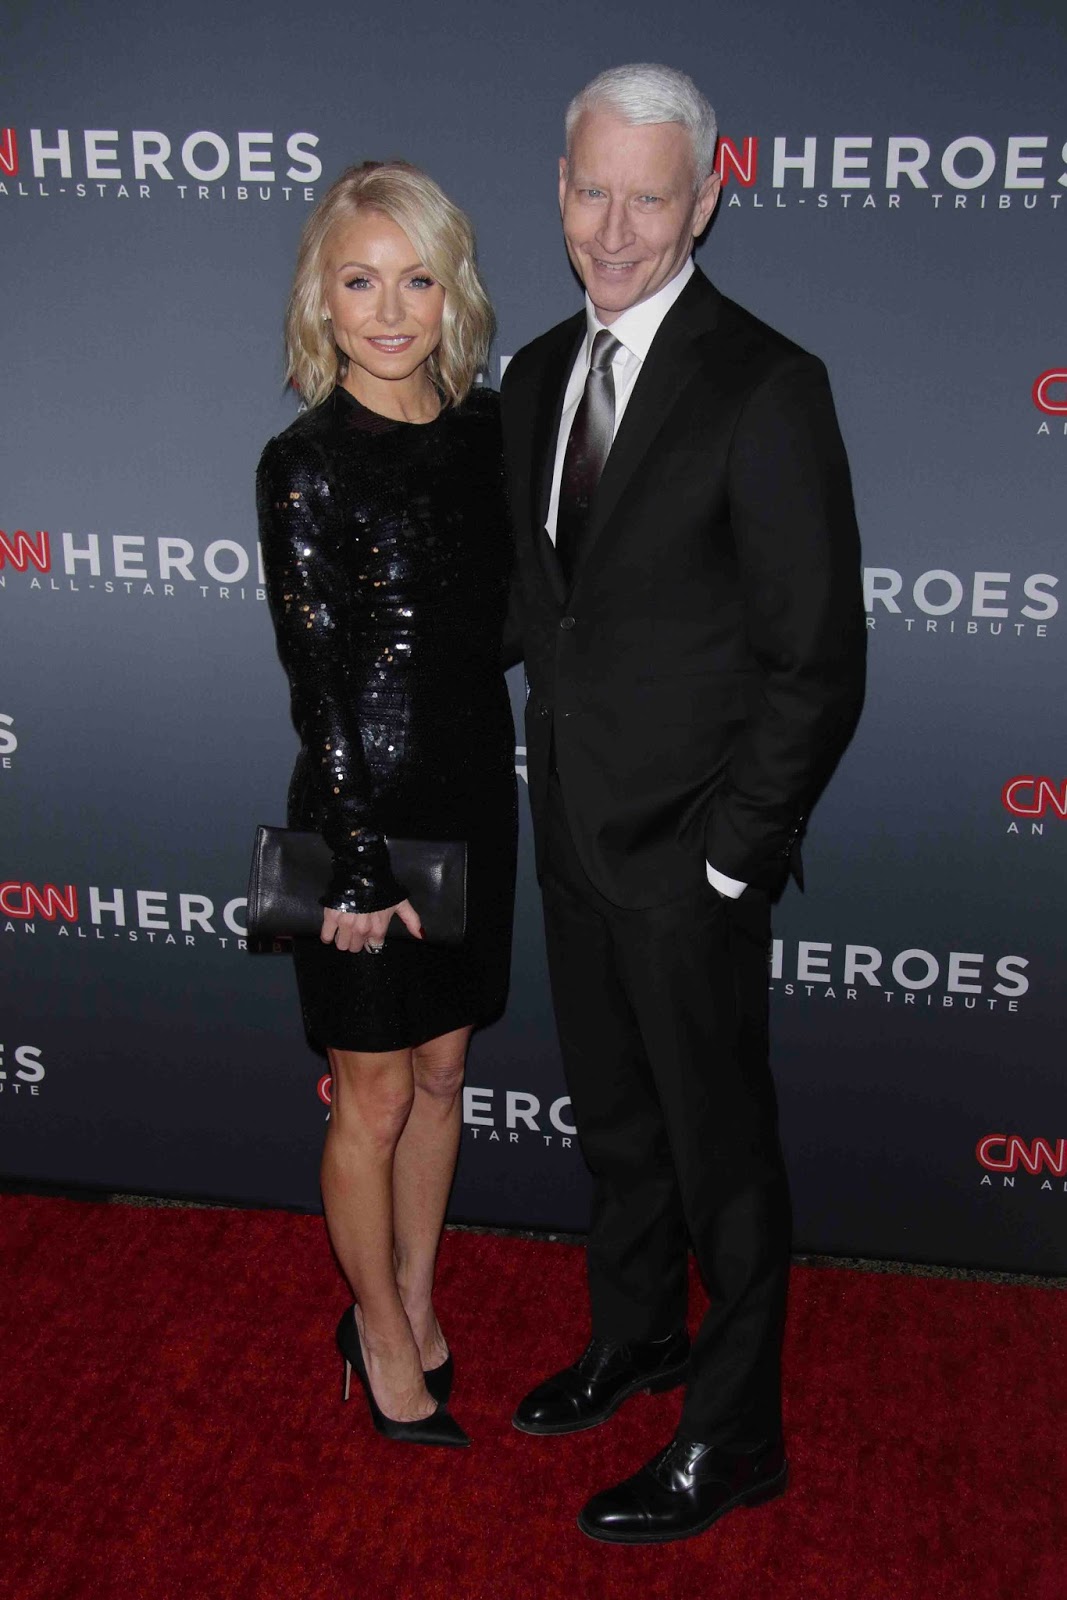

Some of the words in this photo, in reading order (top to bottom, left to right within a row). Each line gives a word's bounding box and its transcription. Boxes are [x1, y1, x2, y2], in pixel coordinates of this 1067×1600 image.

[30, 128, 322, 183] HEROES
[772, 135, 1067, 190] HEROE
[0, 182, 151, 199] ALL-STAR
[177, 186, 315, 201] TRIBUTE
[728, 193, 901, 209] ALL-STAR
[62, 532, 265, 584] HERO
[30, 577, 175, 597] ALL-STAR
[863, 567, 1059, 621] ROES
[905, 619, 1048, 638] TRIBUTE
[1006, 821, 1044, 836] AN
[0, 881, 78, 922] CNN
[5, 922, 36, 934] AN
[58, 925, 196, 946] ALL-STAR
[884, 991, 1019, 1013] TRIBUTE
[976, 1133, 1067, 1178] CNN
[980, 1175, 1015, 1187] AN
